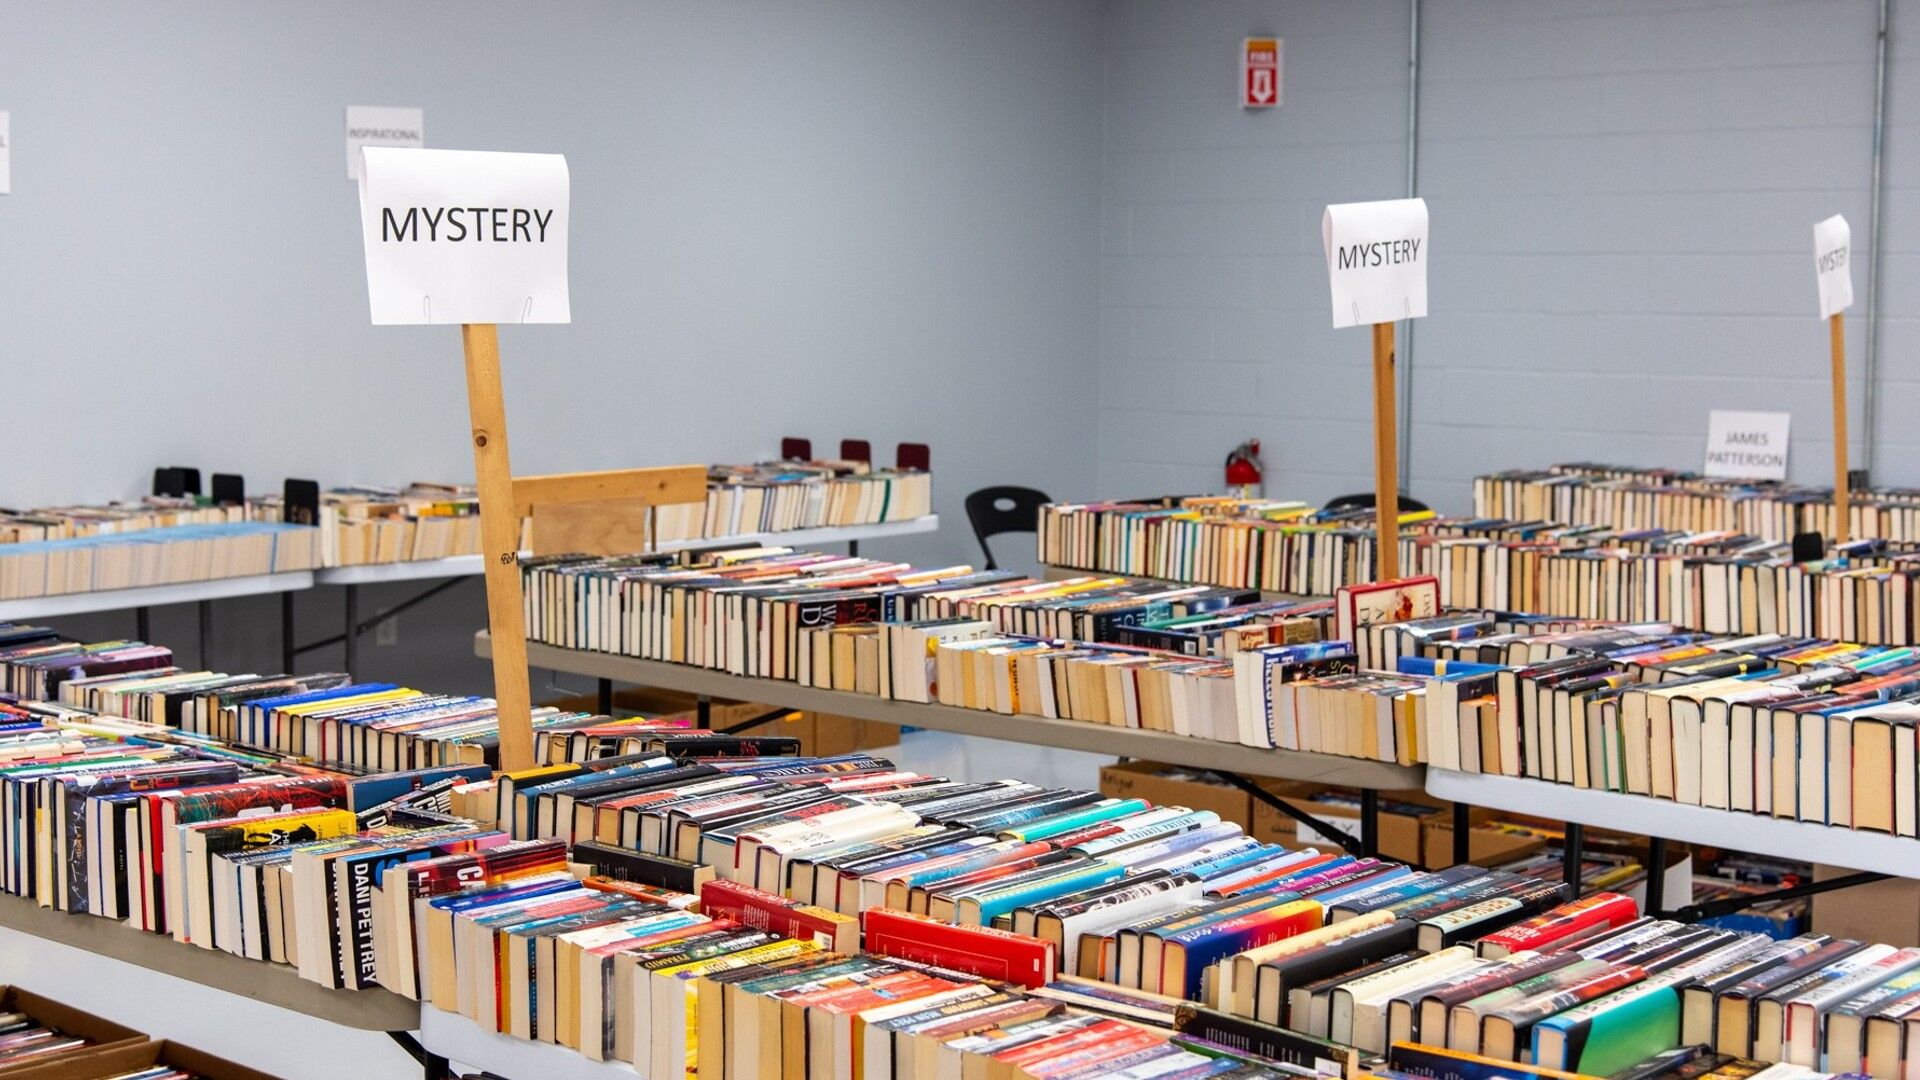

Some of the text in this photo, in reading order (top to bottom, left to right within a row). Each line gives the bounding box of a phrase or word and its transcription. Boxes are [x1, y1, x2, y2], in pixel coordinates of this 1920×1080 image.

[348, 128, 420, 141] INSPIRATIONAL
[382, 207, 553, 242] MYSTERY
[1338, 238, 1421, 270] MYSTERY
[1725, 432, 1769, 447] JAMES
[1707, 451, 1784, 467] PATTERSON
[354, 863, 377, 982] DANI PETTREY
[644, 953, 691, 969] PYRAMID
